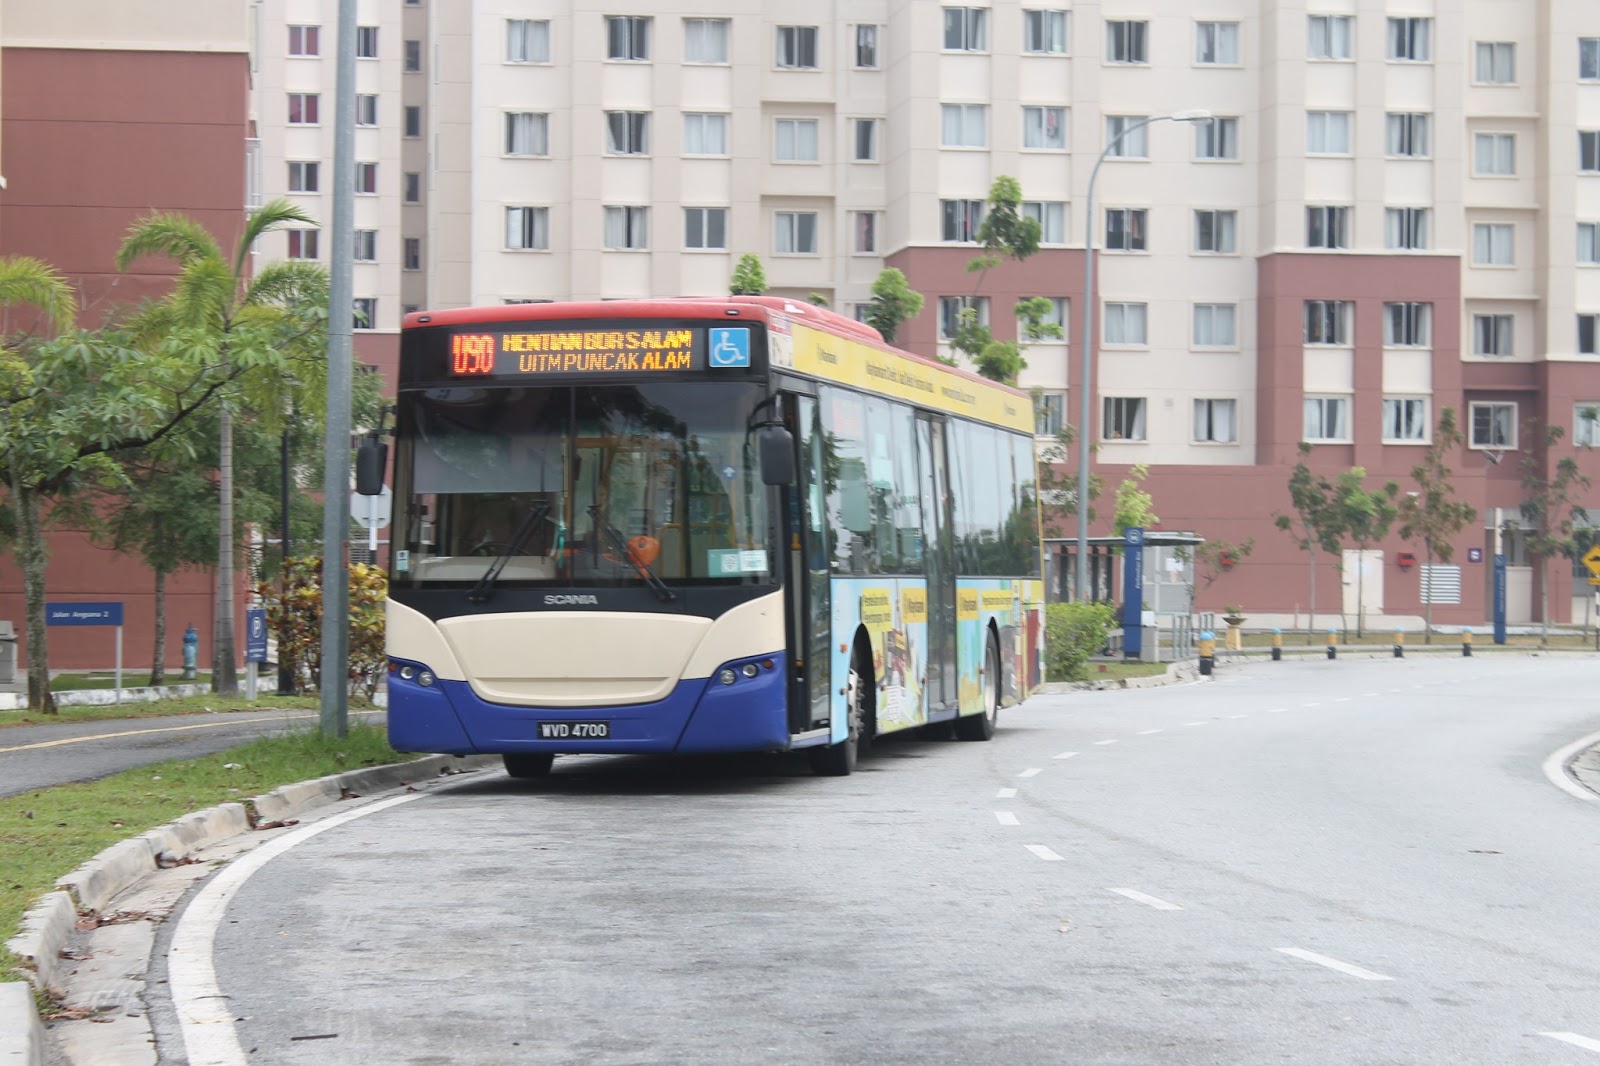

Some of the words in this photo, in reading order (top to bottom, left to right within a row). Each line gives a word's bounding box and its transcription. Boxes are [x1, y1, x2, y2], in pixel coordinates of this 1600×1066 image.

[502, 333, 583, 352] HENTIAN
[452, 335, 495, 374] U90
[520, 354, 561, 372] UITM
[563, 352, 639, 371] PUNCAK
[641, 351, 691, 370] ALAM
[543, 594, 599, 605] SCANIA
[103, 610, 110, 618] 2
[541, 723, 569, 737] WVD
[572, 723, 608, 737] 4700
